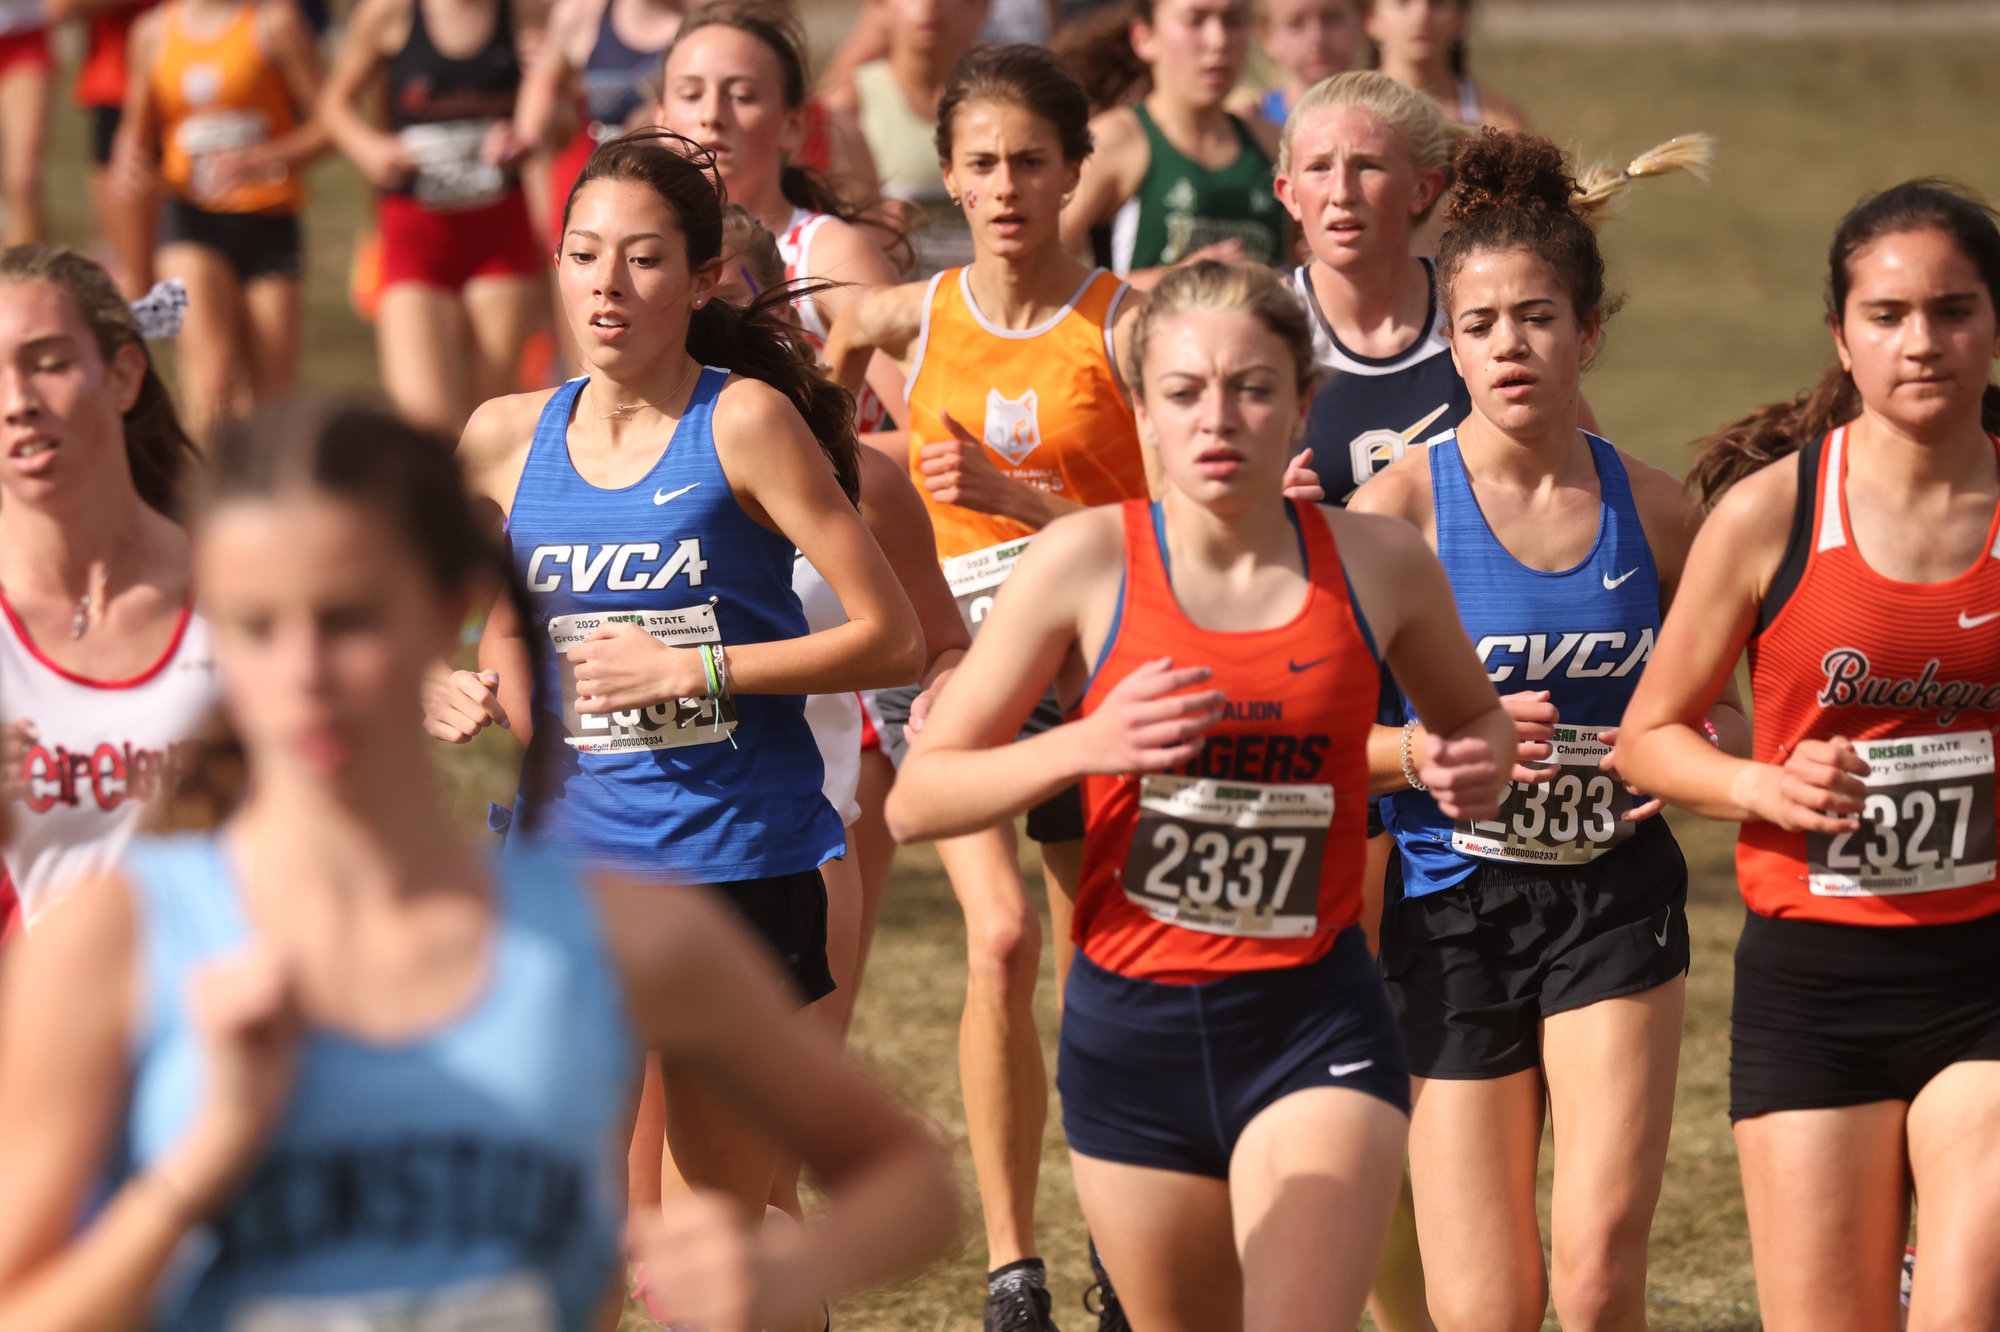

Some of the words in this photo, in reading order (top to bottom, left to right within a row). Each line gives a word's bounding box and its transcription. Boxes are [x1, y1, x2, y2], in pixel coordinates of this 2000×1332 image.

[527, 537, 708, 593] CVCA
[650, 615, 686, 625] STATE
[554, 634, 585, 643] Cross
[651, 625, 714, 637] mpionships
[1475, 627, 1656, 682] CVCA
[1221, 701, 1283, 720] ALION
[1553, 728, 1578, 743] SAA
[1580, 732, 1598, 742] STA
[578, 743, 609, 753] MileSplit
[1557, 744, 1613, 757] Champions
[1921, 741, 1961, 754] STATE
[1162, 734, 1331, 782] GERS
[1894, 753, 1991, 773] Championships
[1465, 843, 1500, 855] MileSplit
[1144, 823, 1307, 910] 2337
